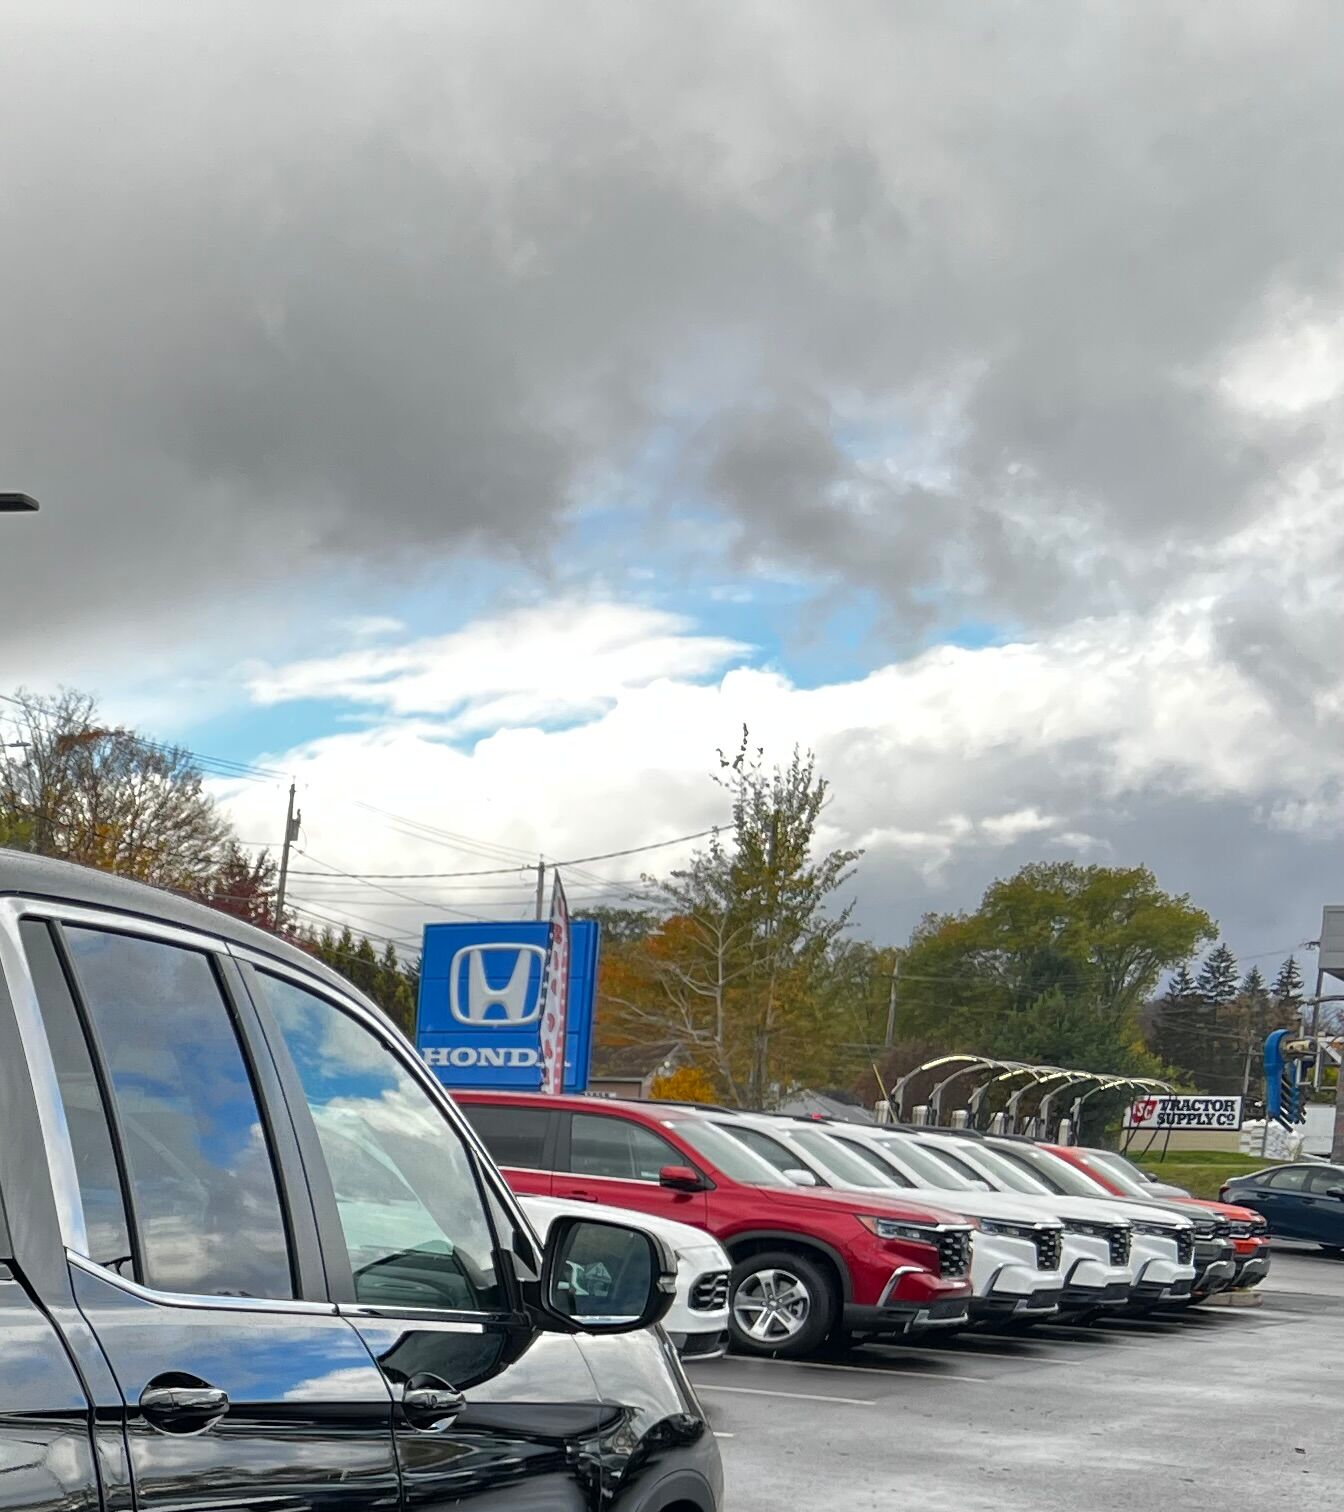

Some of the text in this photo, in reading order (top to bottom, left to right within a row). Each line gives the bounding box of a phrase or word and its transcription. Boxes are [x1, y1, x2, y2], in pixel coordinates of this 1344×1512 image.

[421, 1047, 571, 1067] HOND
[1158, 1099, 1235, 1112] TRACTOR
[1157, 1113, 1216, 1126] SUPPLY
